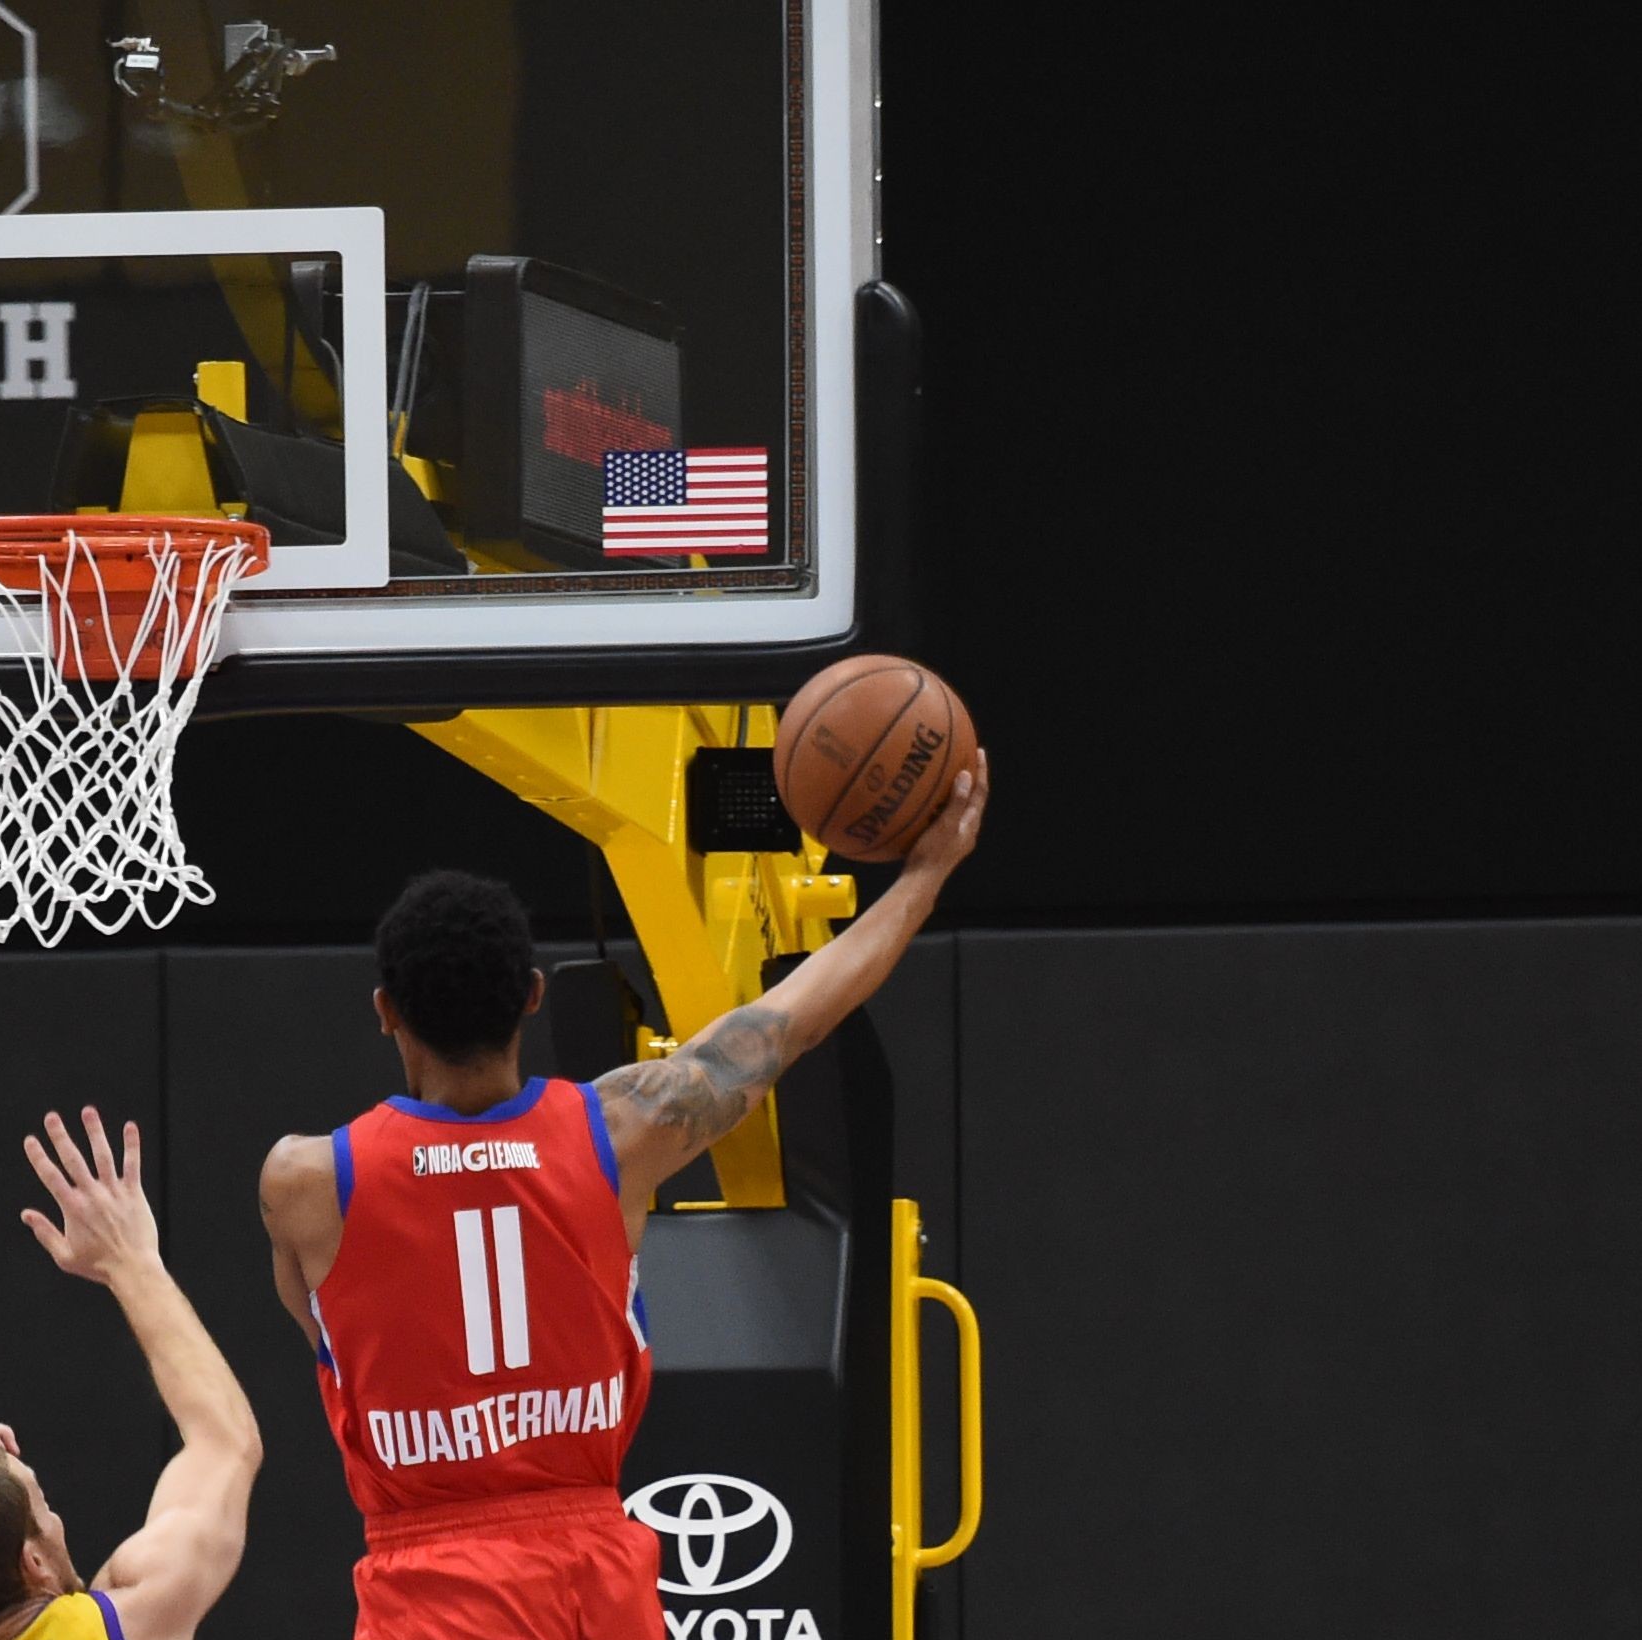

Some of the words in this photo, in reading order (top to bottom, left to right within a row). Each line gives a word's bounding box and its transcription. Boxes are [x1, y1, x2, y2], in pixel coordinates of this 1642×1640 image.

[844, 722, 945, 846] SPALDING
[453, 1206, 531, 1376] 11
[368, 1370, 624, 1471] QUARTERMAN
